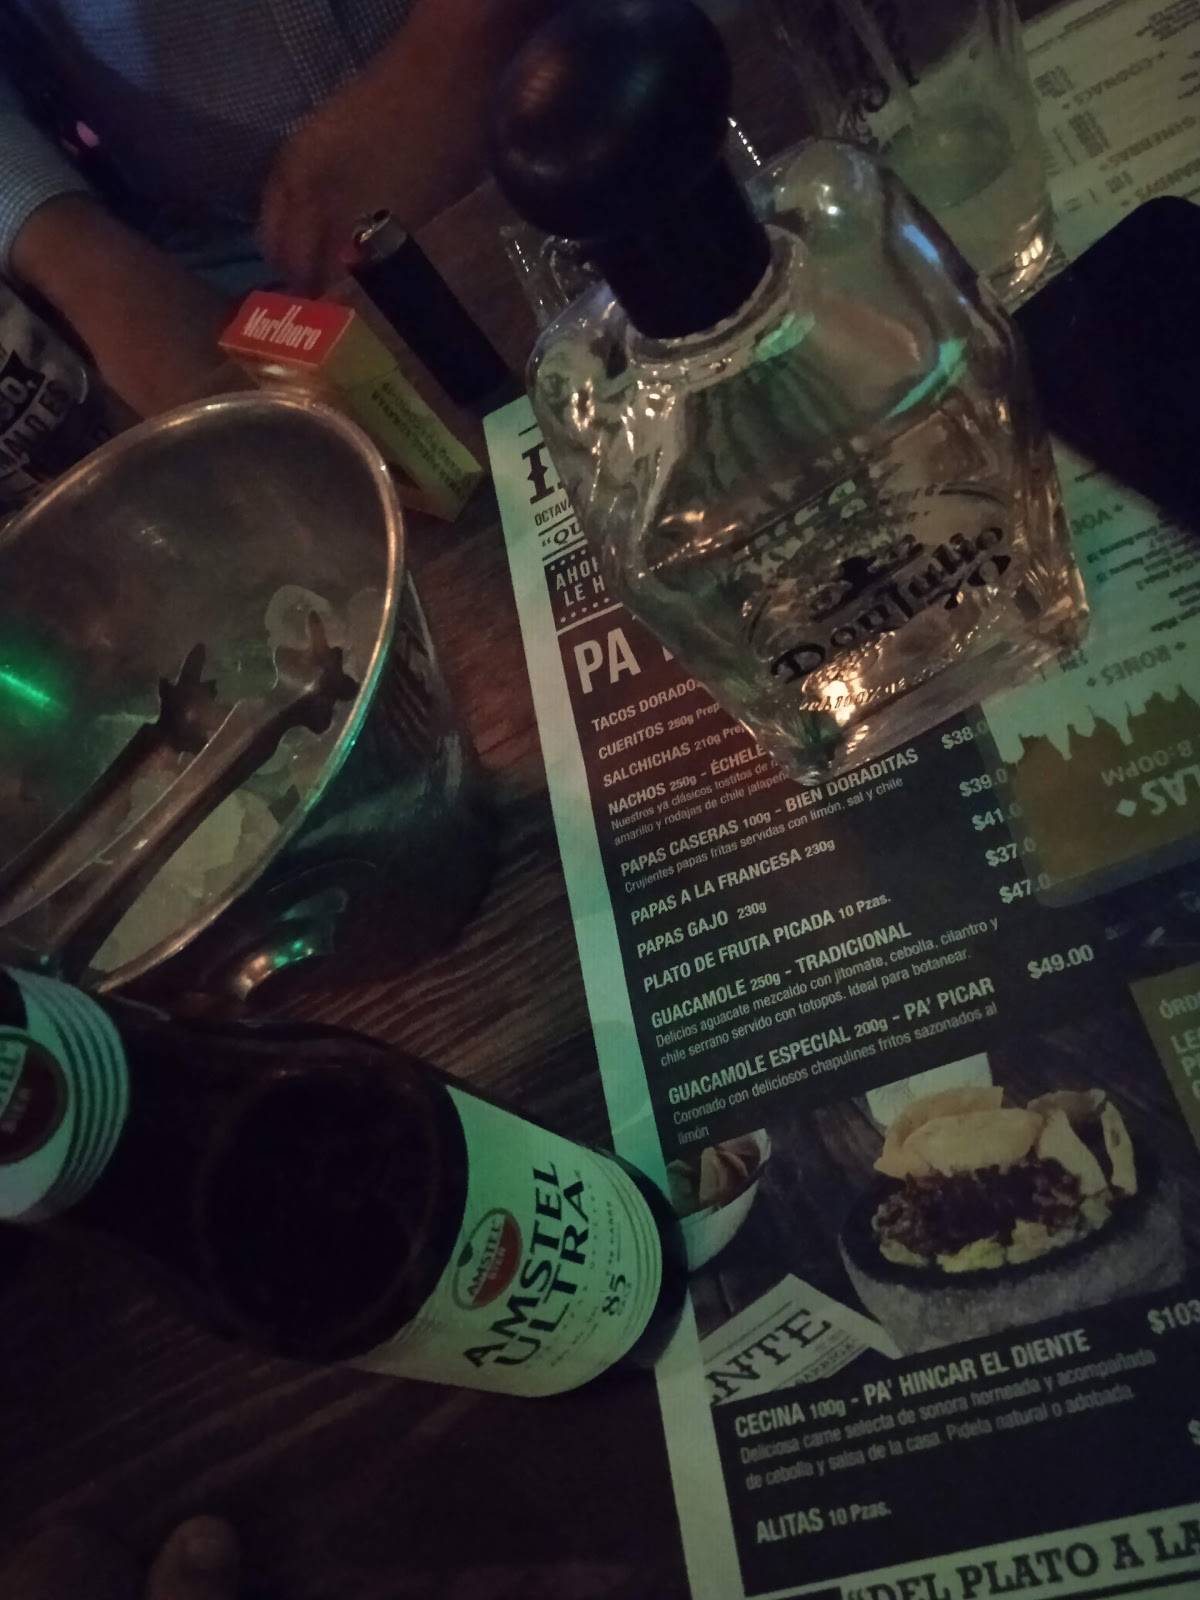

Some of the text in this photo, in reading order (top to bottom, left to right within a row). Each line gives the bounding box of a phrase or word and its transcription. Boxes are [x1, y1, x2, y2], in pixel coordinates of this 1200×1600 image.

[241, 304, 322, 351] Marlboro
[564, 583, 586, 608] LE
[573, 627, 641, 695] PA
[1101, 644, 1172, 686] RONES
[592, 705, 636, 732] TACOS
[598, 722, 664, 760] CUERITOS
[668, 714, 694, 731] 250g
[603, 742, 691, 788] SALCHICHAS
[694, 734, 721, 751] 210g
[608, 782, 666, 815] NACHOS
[670, 774, 697, 791] 250g
[710, 744, 767, 775] ÉCHELE
[611, 808, 654, 830] Nuestros
[657, 802, 669, 815] ya
[755, 763, 768, 774] de
[614, 824, 654, 846] amarillo
[656, 820, 663, 830] y
[664, 803, 703, 825] rodajas
[705, 798, 718, 810] de
[720, 786, 744, 804] chile
[620, 847, 667, 877] PAPAS
[669, 820, 739, 856] CASERAS
[742, 811, 772, 828] 100g
[785, 787, 823, 812] BIEN
[826, 747, 919, 797] DORADITAS
[624, 865, 675, 894] Crujientes
[676, 853, 709, 873] papas
[710, 841, 738, 859] fritas
[740, 822, 785, 847] servidas
[787, 815, 808, 830] con
[847, 792, 864, 806] sal
[865, 789, 873, 801] y
[876, 777, 904, 796] chile
[631, 839, 836, 925] PAPAS A LA FRANCESA 230g
[637, 901, 767, 959] PAPAS GAJO 230g
[643, 894, 891, 993] PLATO DE FRUTA PICADA 10 Pzas.
[1026, 942, 1096, 980] $49.00
[651, 978, 747, 1028] GUACAMOLE
[751, 972, 781, 991] 250g
[795, 921, 912, 974] TRADICIONAL
[655, 1023, 698, 1048] Delicios
[700, 1003, 750, 1031] aguacate
[752, 983, 807, 1010] mezcaldo
[810, 974, 832, 990] con
[940, 921, 988, 946] cilantro
[990, 917, 999, 931] y
[660, 1047, 687, 1067] chile
[688, 1032, 730, 1056] serrano
[731, 1015, 772, 1040] servido
[775, 1008, 796, 1023] con
[848, 976, 879, 997] Ideal
[881, 968, 910, 989] para
[911, 948, 972, 976] botanear.
[668, 1054, 768, 1105] GUACAMOLE
[769, 1025, 851, 1068] ESPECIAL
[854, 1017, 888, 1038] 200g
[904, 996, 931, 1021] PA'
[937, 977, 995, 1010] PICAR
[673, 1001, 998, 1125] Coronado con deliciosos chapulines fritos sazonados al
[678, 1125, 710, 1145] limón
[463, 1161, 562, 1368] AMSTEL
[494, 1180, 590, 1365] ULTRA
[711, 1309, 832, 1405] NTE
[735, 1402, 805, 1438] CECINA
[809, 1398, 847, 1420] 100g
[863, 1378, 893, 1407] PA'
[899, 1358, 978, 1397] HINCAR
[980, 1350, 1010, 1376] EL
[1010, 1328, 1091, 1369] DIENTE
[746, 1473, 763, 1491] de
[816, 1460, 825, 1477] y
[867, 1443, 887, 1461] de
[995, 1402, 1048, 1431] natural
[803, 1428, 842, 1448] carne
[898, 1409, 916, 1425] de
[918, 1395, 969, 1421] sonora
[1043, 1374, 1054, 1393] y
[756, 1501, 892, 1544] ALITAS 10 Pzas.
[956, 1541, 1099, 1600] PLATO
[1111, 1533, 1145, 1570] A
